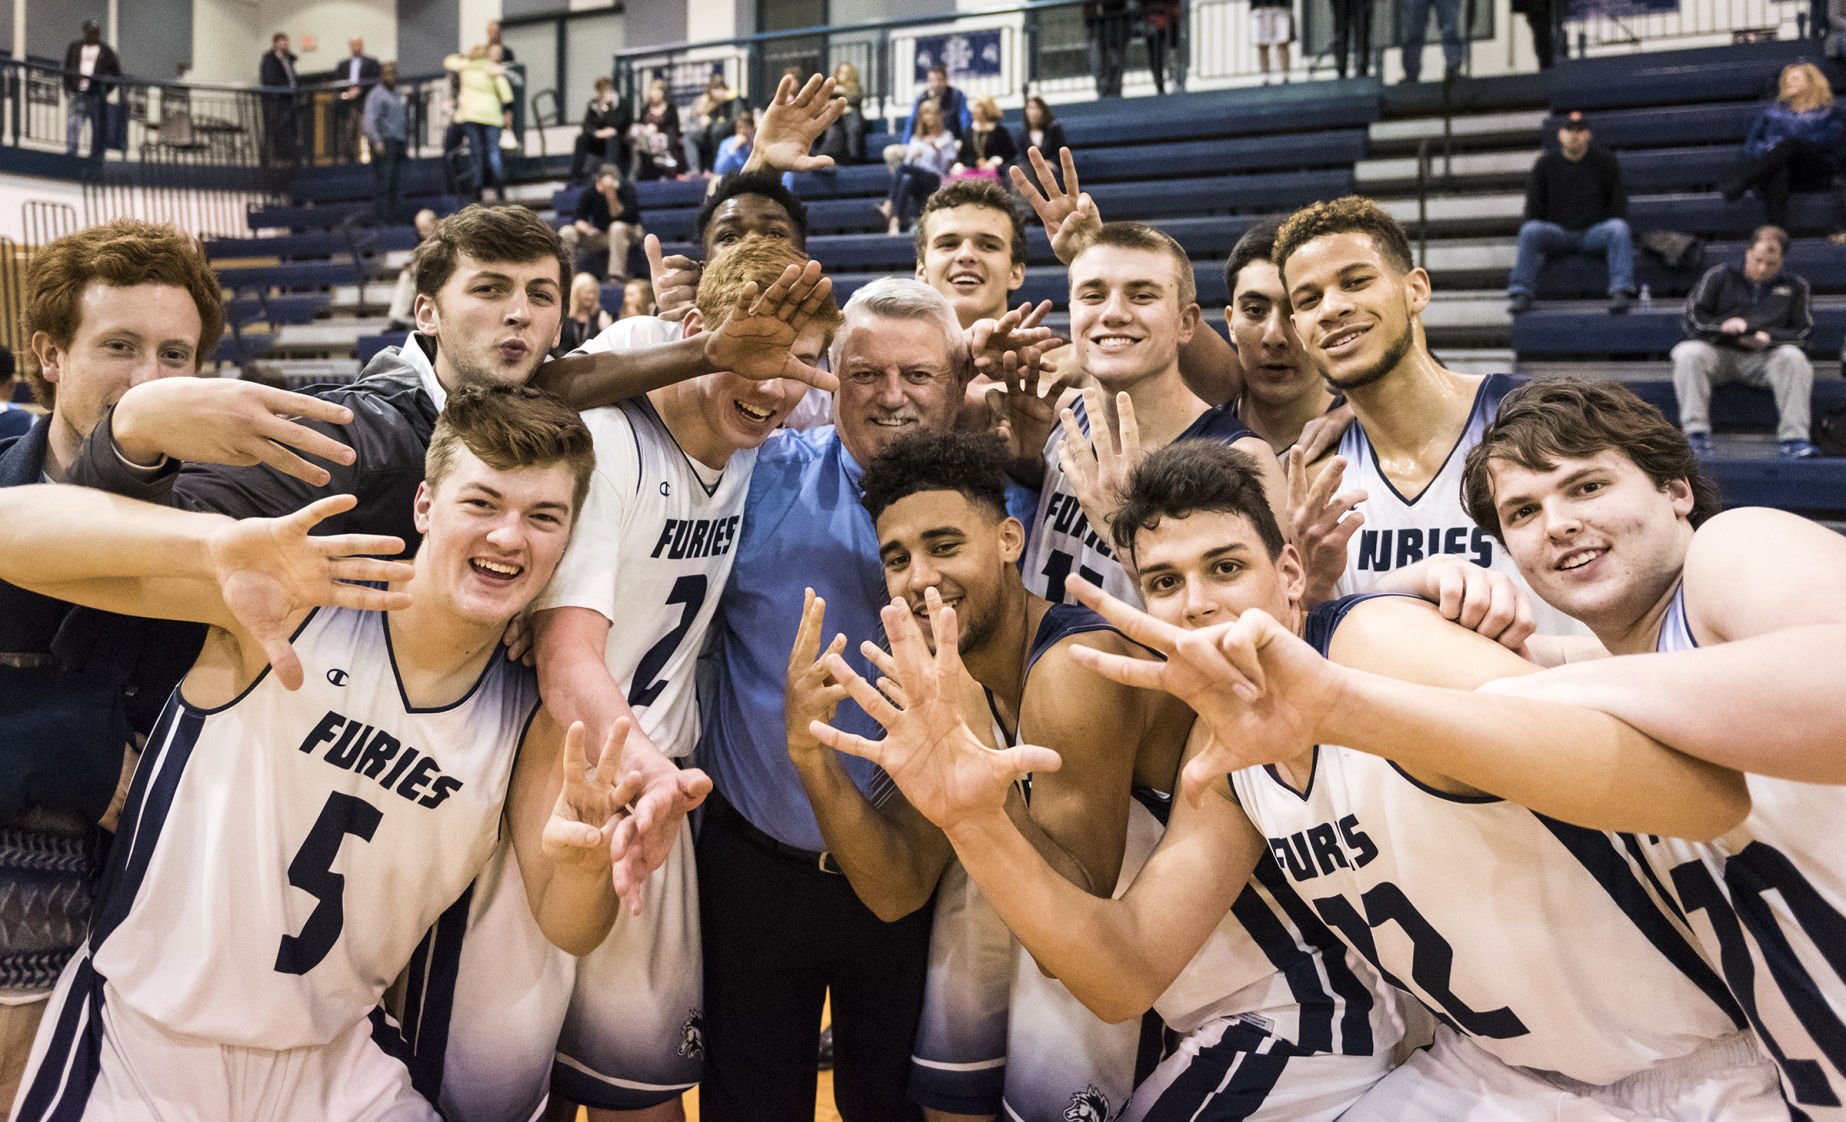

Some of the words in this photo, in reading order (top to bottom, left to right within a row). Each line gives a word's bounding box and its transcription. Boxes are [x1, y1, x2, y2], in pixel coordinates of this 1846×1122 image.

[650, 515, 740, 559] FURIES
[1041, 549, 1104, 604] 1
[628, 574, 708, 707] 2
[299, 710, 464, 809] FURIES
[274, 790, 384, 976] 5
